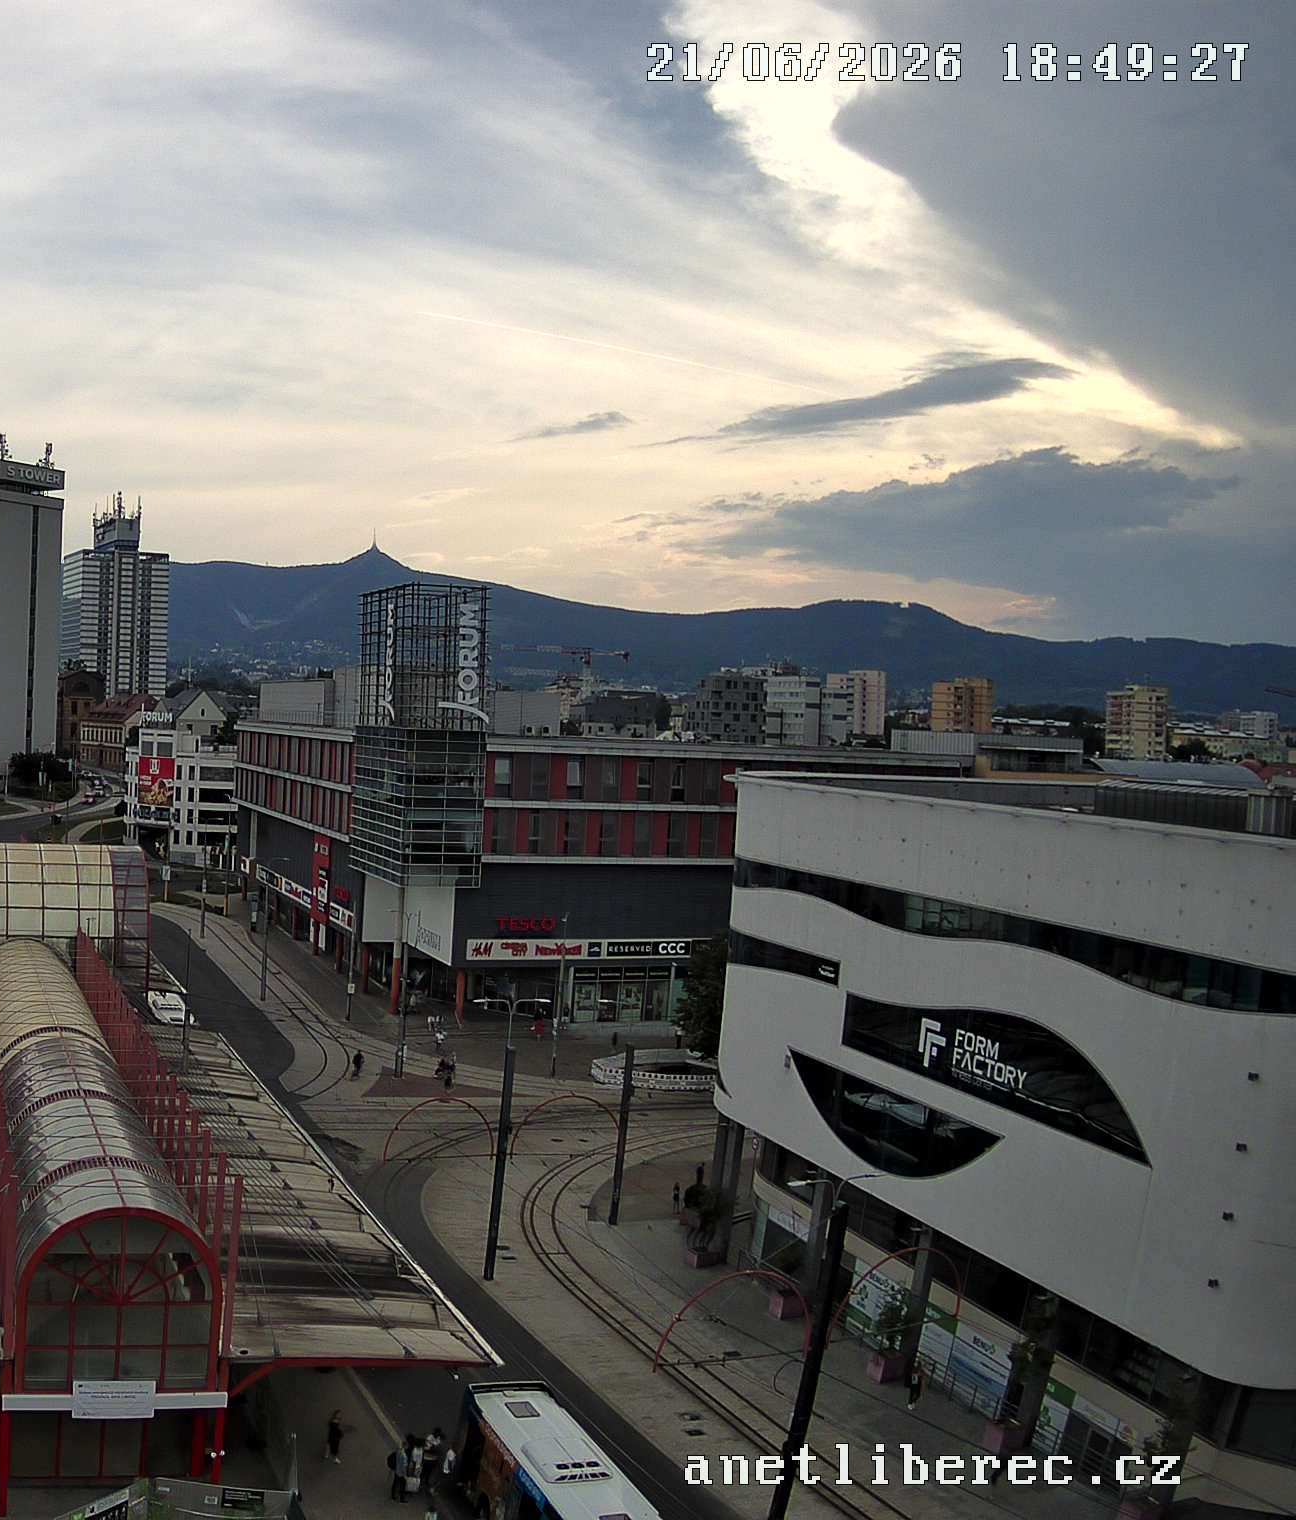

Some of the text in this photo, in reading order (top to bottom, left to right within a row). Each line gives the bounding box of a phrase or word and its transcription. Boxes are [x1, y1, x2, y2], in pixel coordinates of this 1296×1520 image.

[6, 465, 61, 485] S TOWER
[496, 915, 557, 933] TESCO
[471, 942, 494, 957] H&M
[608, 944, 652, 953] RESERVED
[658, 942, 686, 954] CCC
[954, 1028, 1000, 1061] FORM
[952, 1048, 1029, 1090] FACTORY
